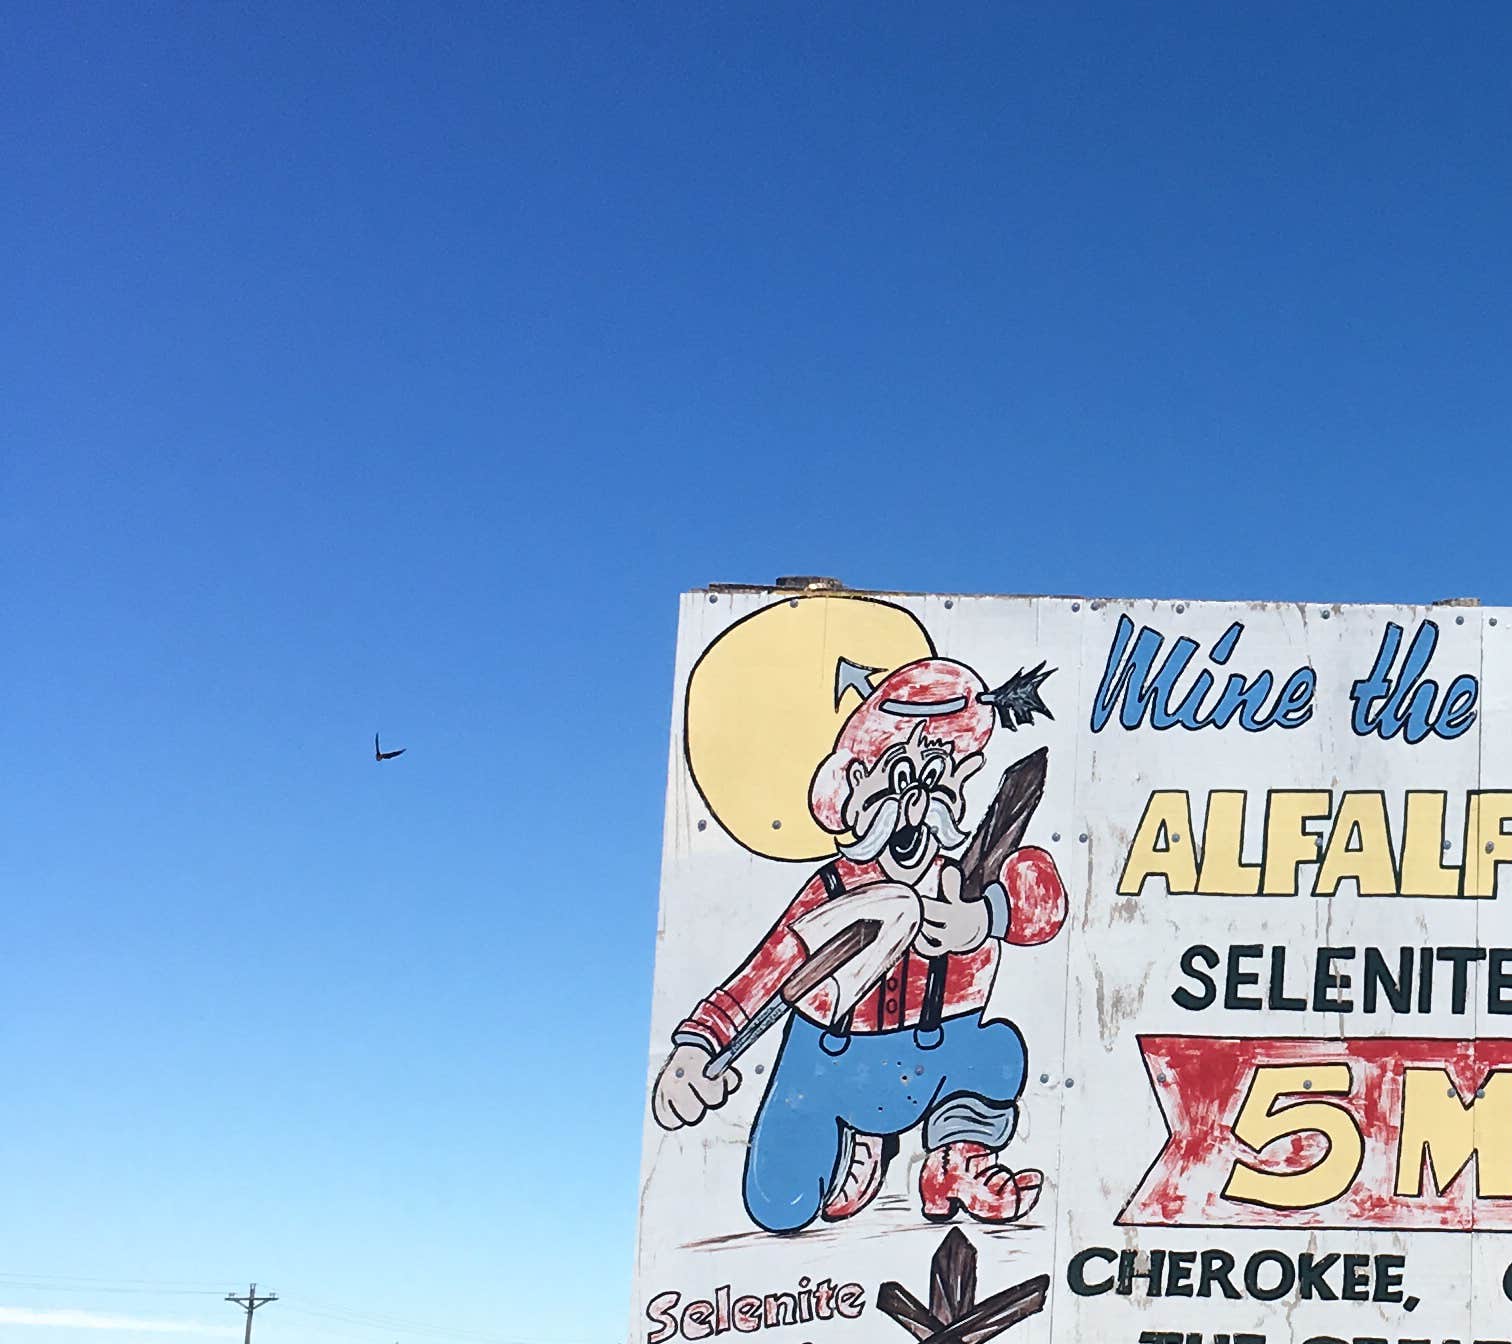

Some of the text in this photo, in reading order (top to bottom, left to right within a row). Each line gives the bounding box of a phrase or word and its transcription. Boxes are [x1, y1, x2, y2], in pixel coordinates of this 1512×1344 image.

[1091, 613, 1317, 732] Mine
[1350, 619, 1479, 744] the
[1220, 1062, 1366, 1210] 5
[1066, 1246, 1421, 1312] CHEROKEE,
